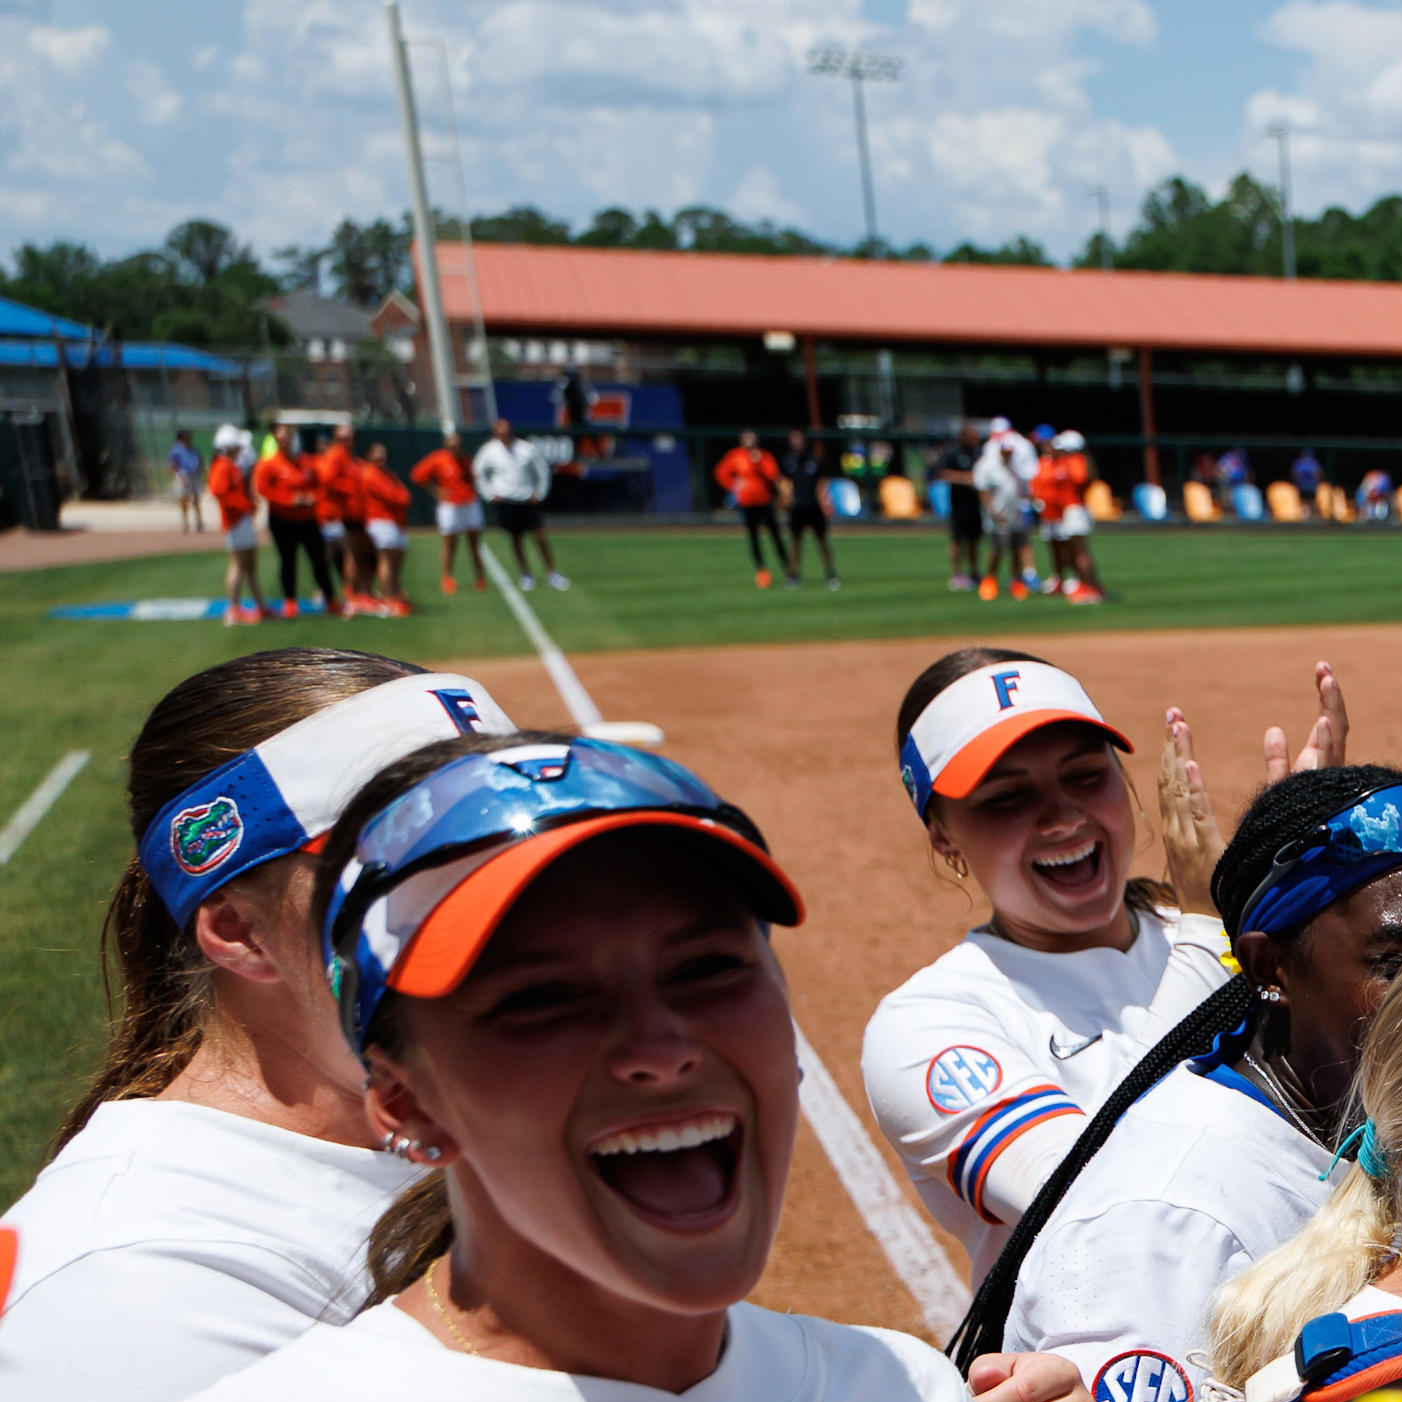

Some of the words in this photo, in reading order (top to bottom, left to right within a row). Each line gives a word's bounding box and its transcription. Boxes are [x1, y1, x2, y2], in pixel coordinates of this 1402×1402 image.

[425, 688, 482, 737] F
[987, 670, 1022, 712] F
[929, 1048, 1000, 1110] SEC
